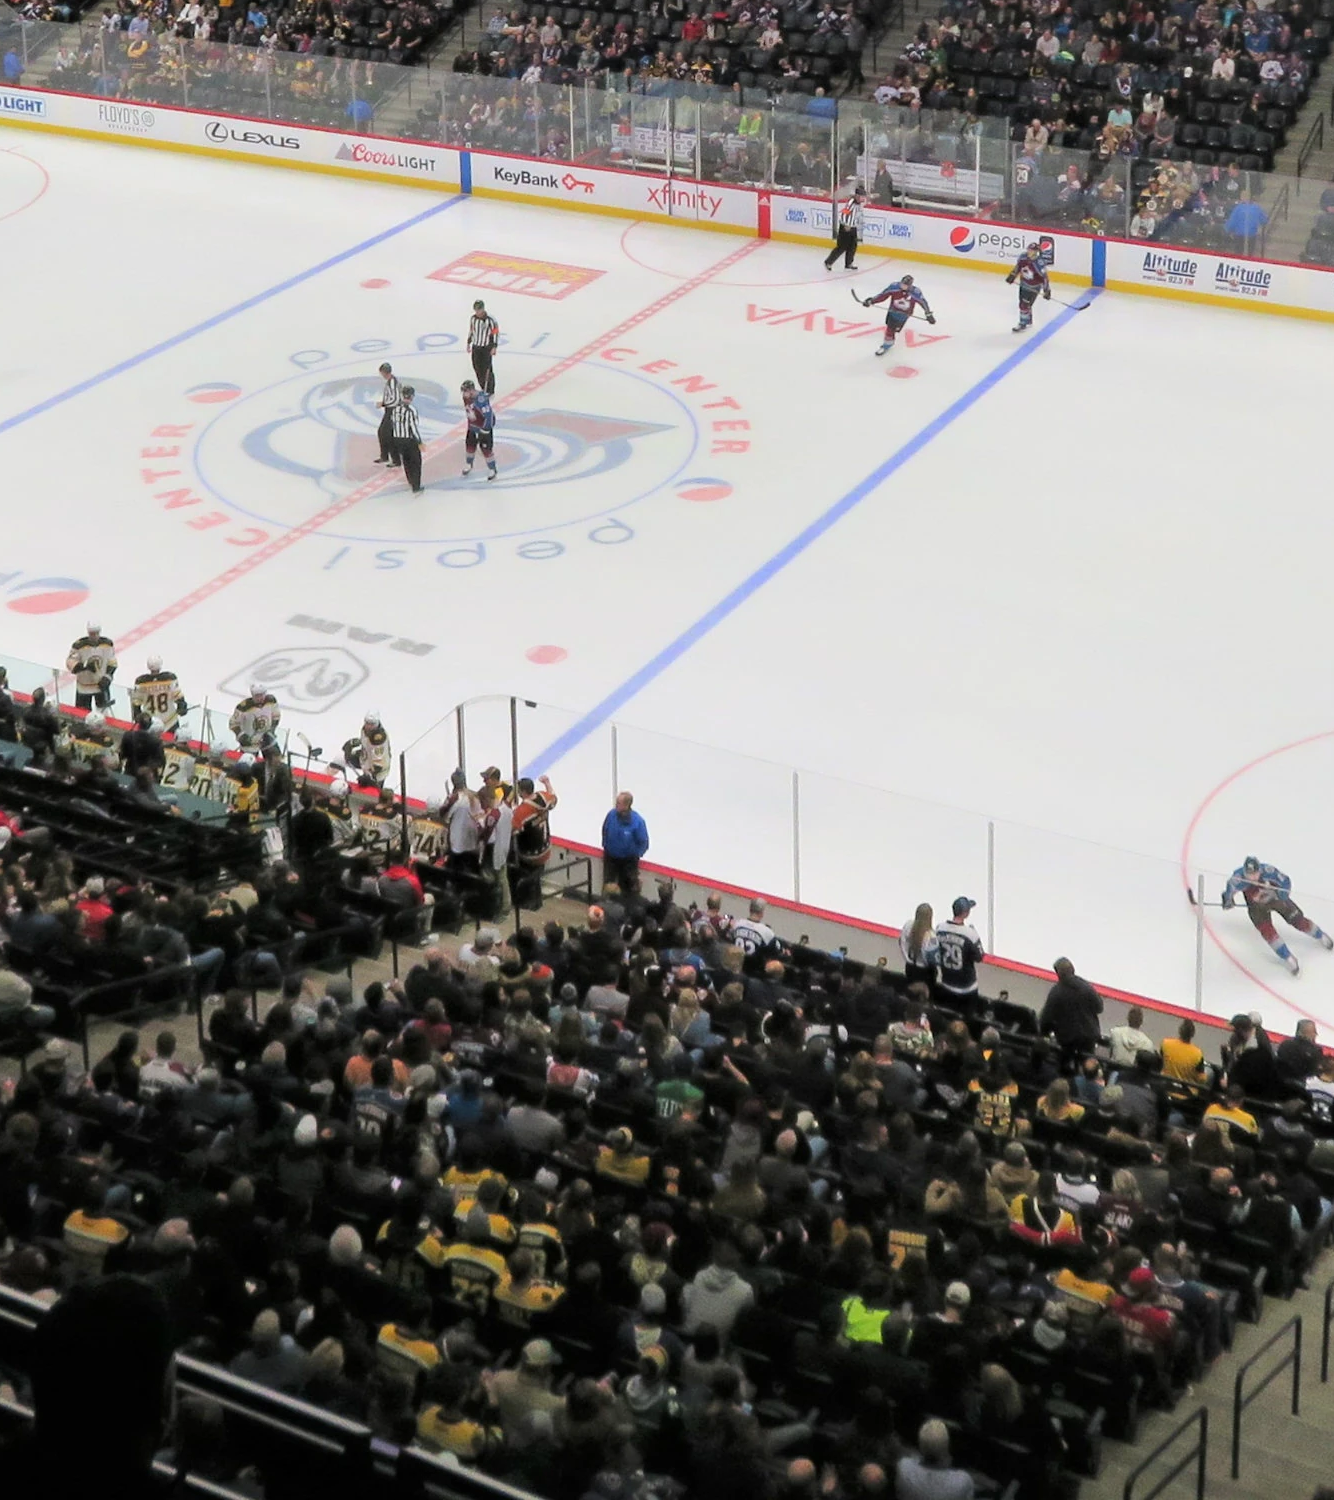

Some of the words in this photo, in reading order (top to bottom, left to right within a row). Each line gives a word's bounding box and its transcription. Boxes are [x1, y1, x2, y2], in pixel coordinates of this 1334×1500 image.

[3, 95, 43, 113] LIGHT
[99, 104, 140, 127] FLOYD'S
[230, 128, 301, 151] LEXUS
[351, 143, 396, 168] Coors
[397, 153, 437, 172] LIGHT
[494, 167, 559, 189] KeyBank
[646, 183, 724, 217] xfinity
[978, 232, 1026, 250] pepsi
[1142, 252, 1198, 274] Altitude
[1215, 262, 1272, 286] Altitude
[443, 265, 570, 296] KING
[1168, 275, 1184, 285] 92.5
[1241, 286, 1257, 296] 92.5
[746, 303, 953, 348] AVAYA
[289, 329, 553, 369] pepsi
[601, 346, 752, 456] CENTER
[139, 421, 270, 549] CENTER
[323, 517, 635, 571] pepsi
[147, 692, 169, 714] 48
[942, 943, 964, 970] 29
